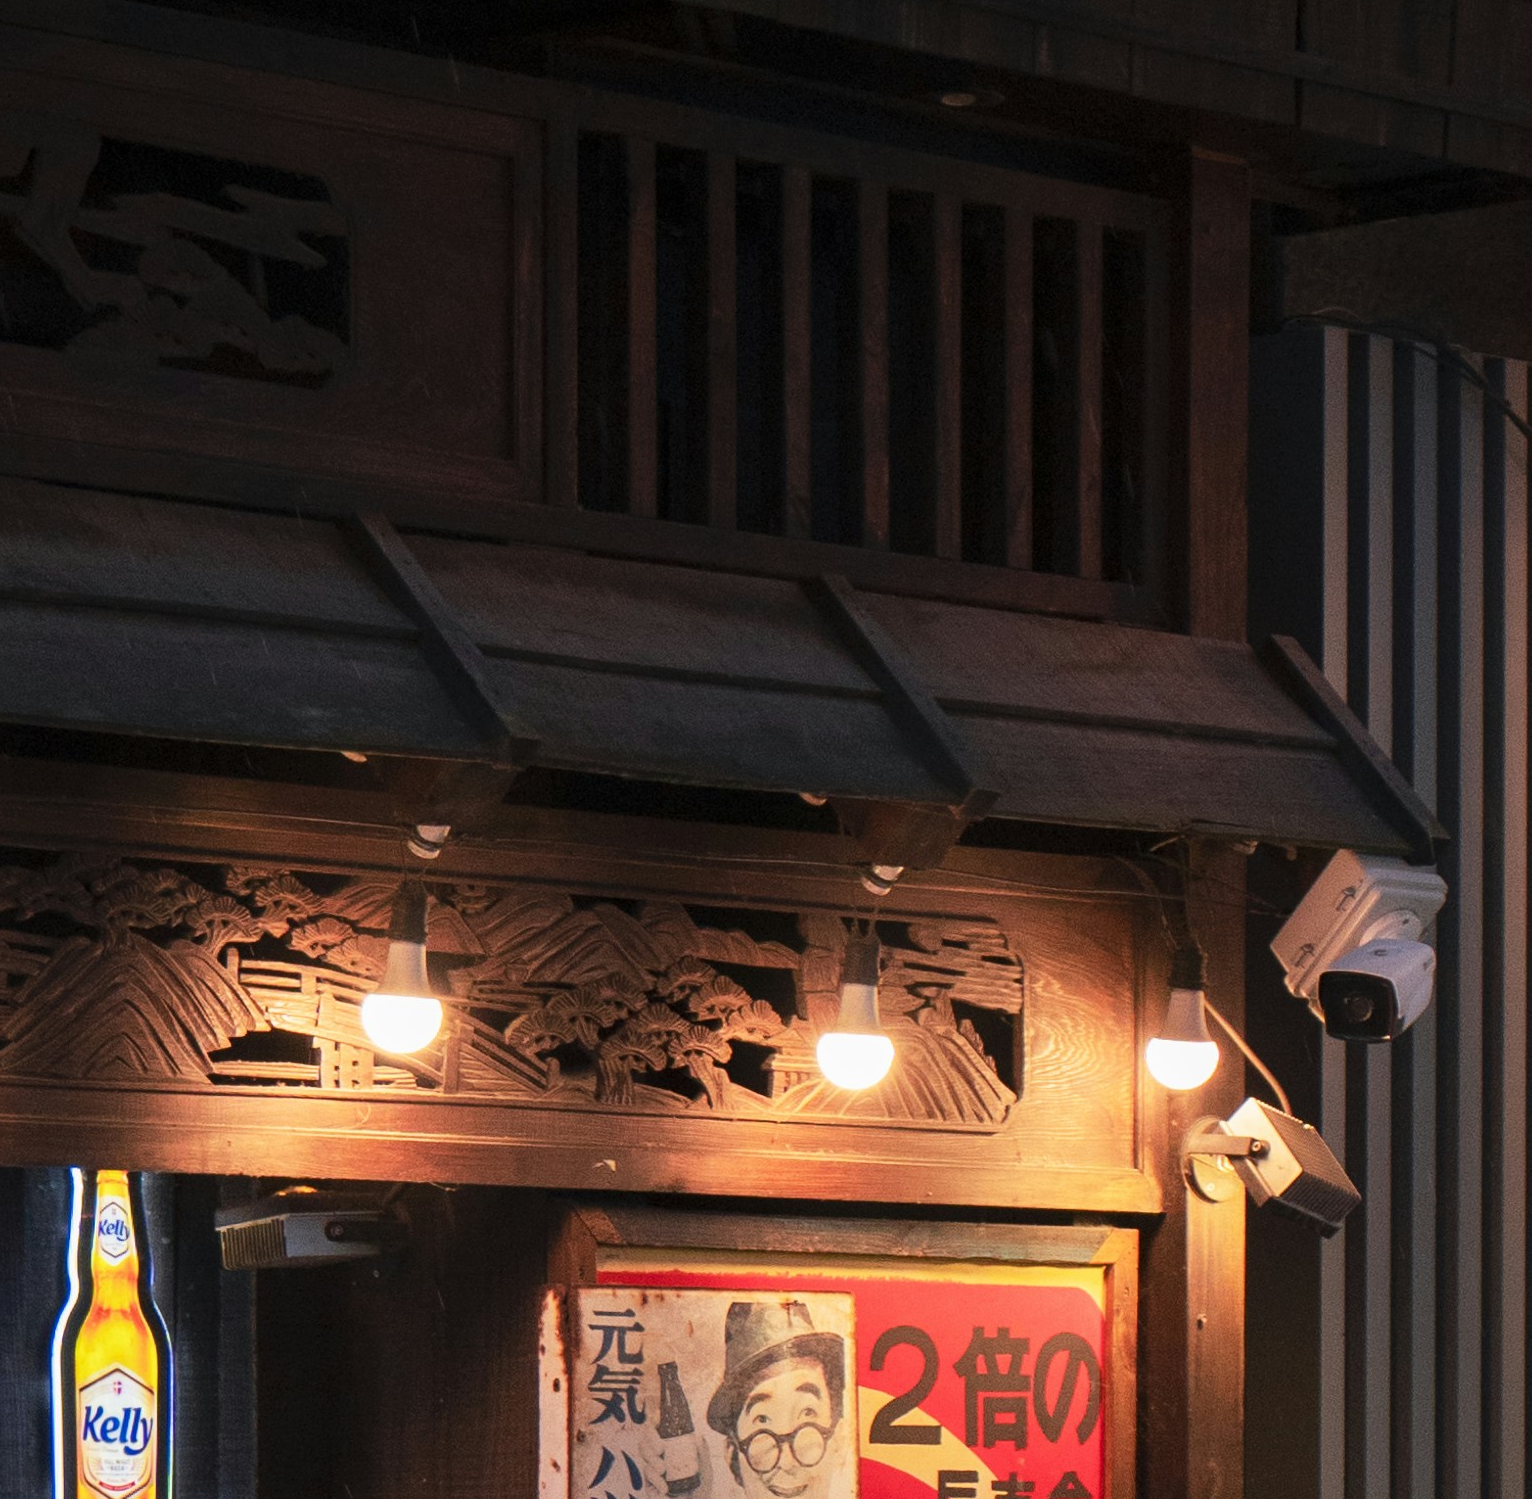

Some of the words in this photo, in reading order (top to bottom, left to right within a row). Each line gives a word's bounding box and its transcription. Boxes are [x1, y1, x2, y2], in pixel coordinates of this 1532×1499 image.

[97, 1218, 131, 1243] Kelly
[869, 1325, 1102, 1451] 2倍の
[82, 1404, 154, 1457] Kelly
